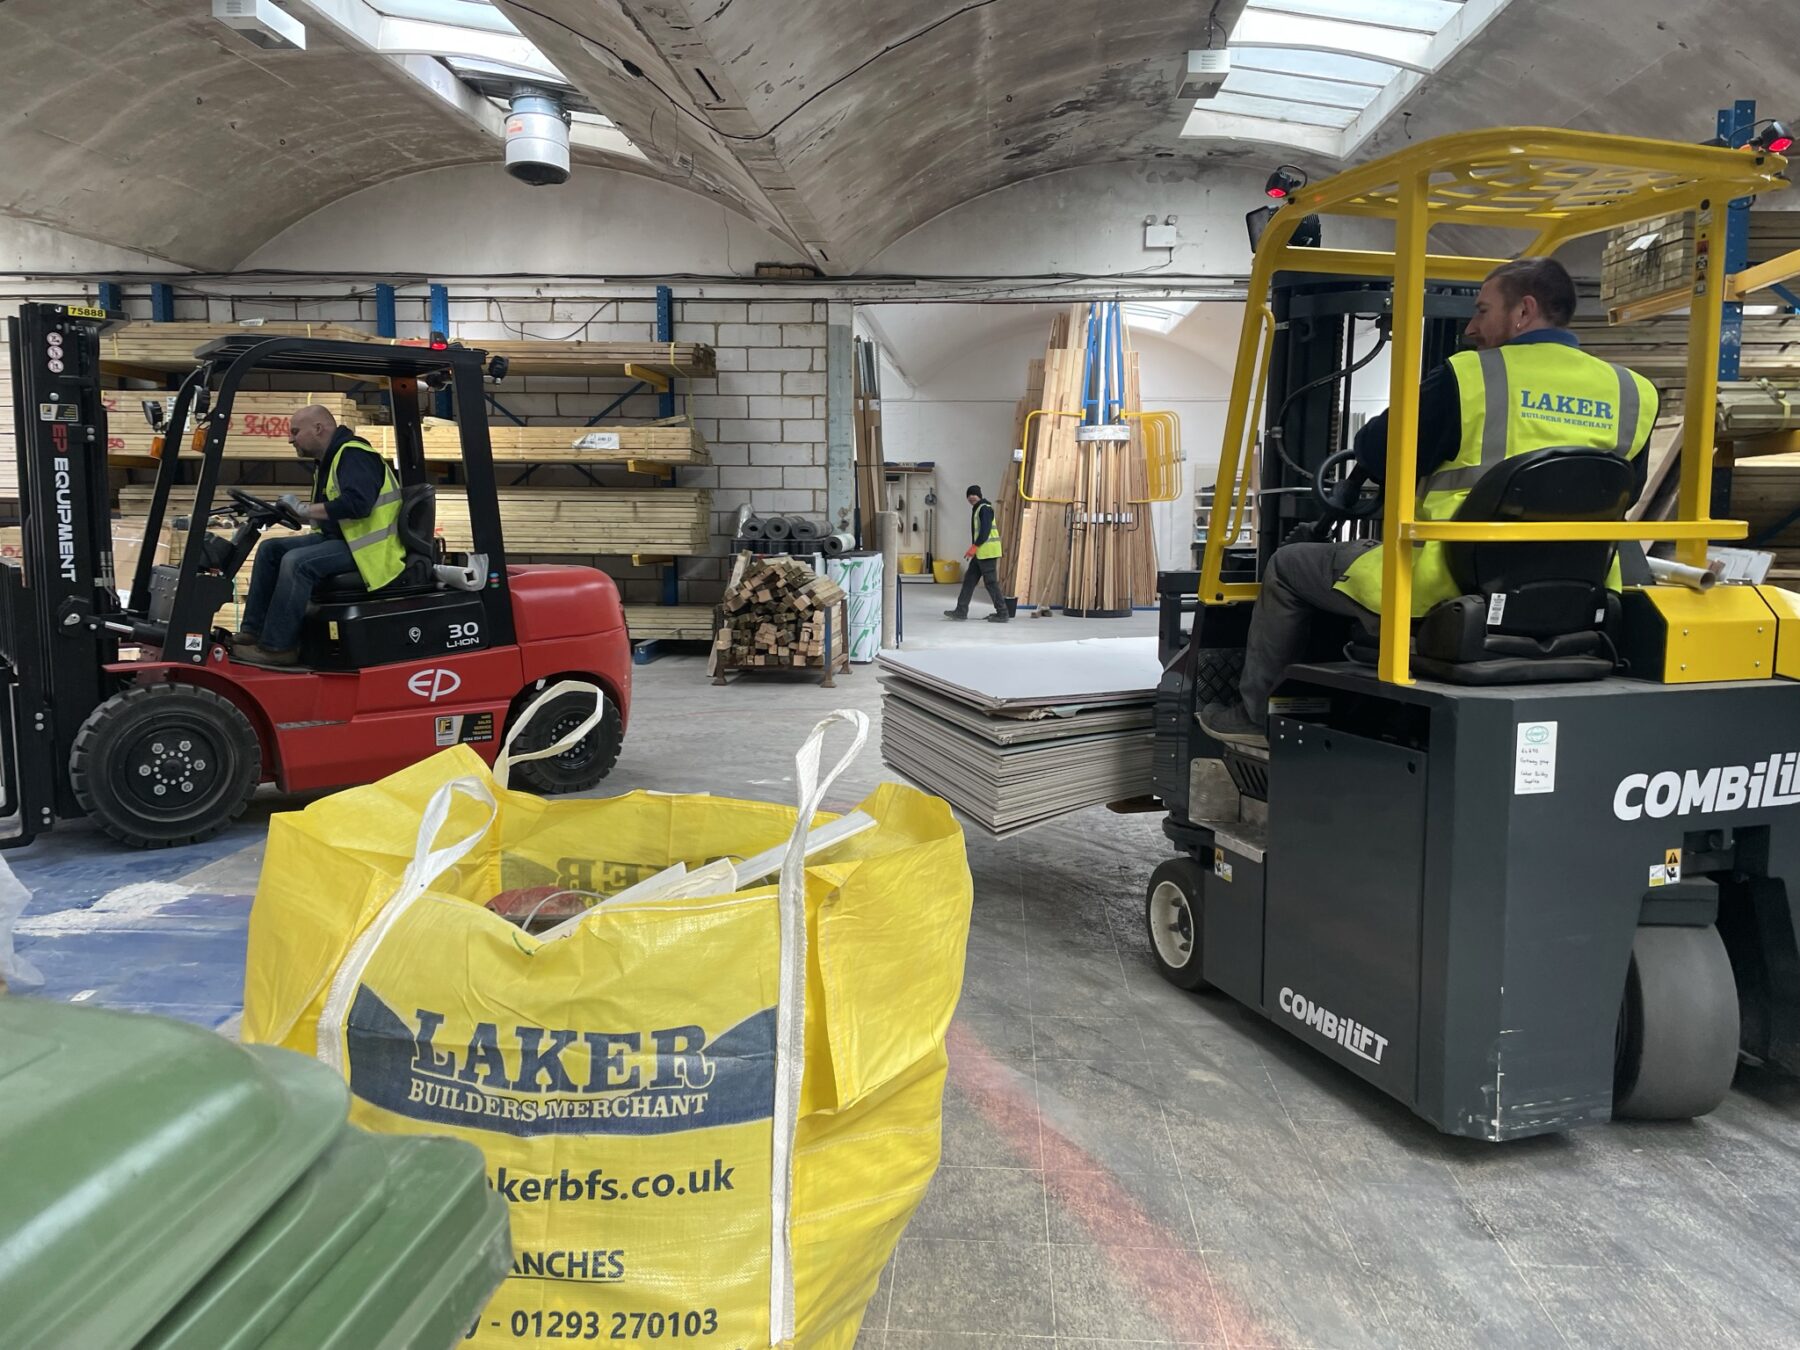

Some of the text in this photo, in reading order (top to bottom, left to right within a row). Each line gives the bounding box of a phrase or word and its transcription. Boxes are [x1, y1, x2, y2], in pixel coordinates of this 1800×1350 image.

[70, 307, 104, 317] 75888
[1521, 390, 1613, 419] LAKER
[51, 423, 68, 453] EP
[1564, 417, 1613, 430] MERCHANT
[53, 457, 77, 583] EQUIPMENT
[448, 621, 479, 639] 30
[407, 668, 461, 702] EP
[1613, 752, 1800, 821] COMBiLi
[411, 1008, 715, 1094] LAKER
[407, 1077, 708, 1122] BUILDERS MERCHANT
[511, 1310, 600, 1339] 01293
[610, 1308, 718, 1339] 270103
